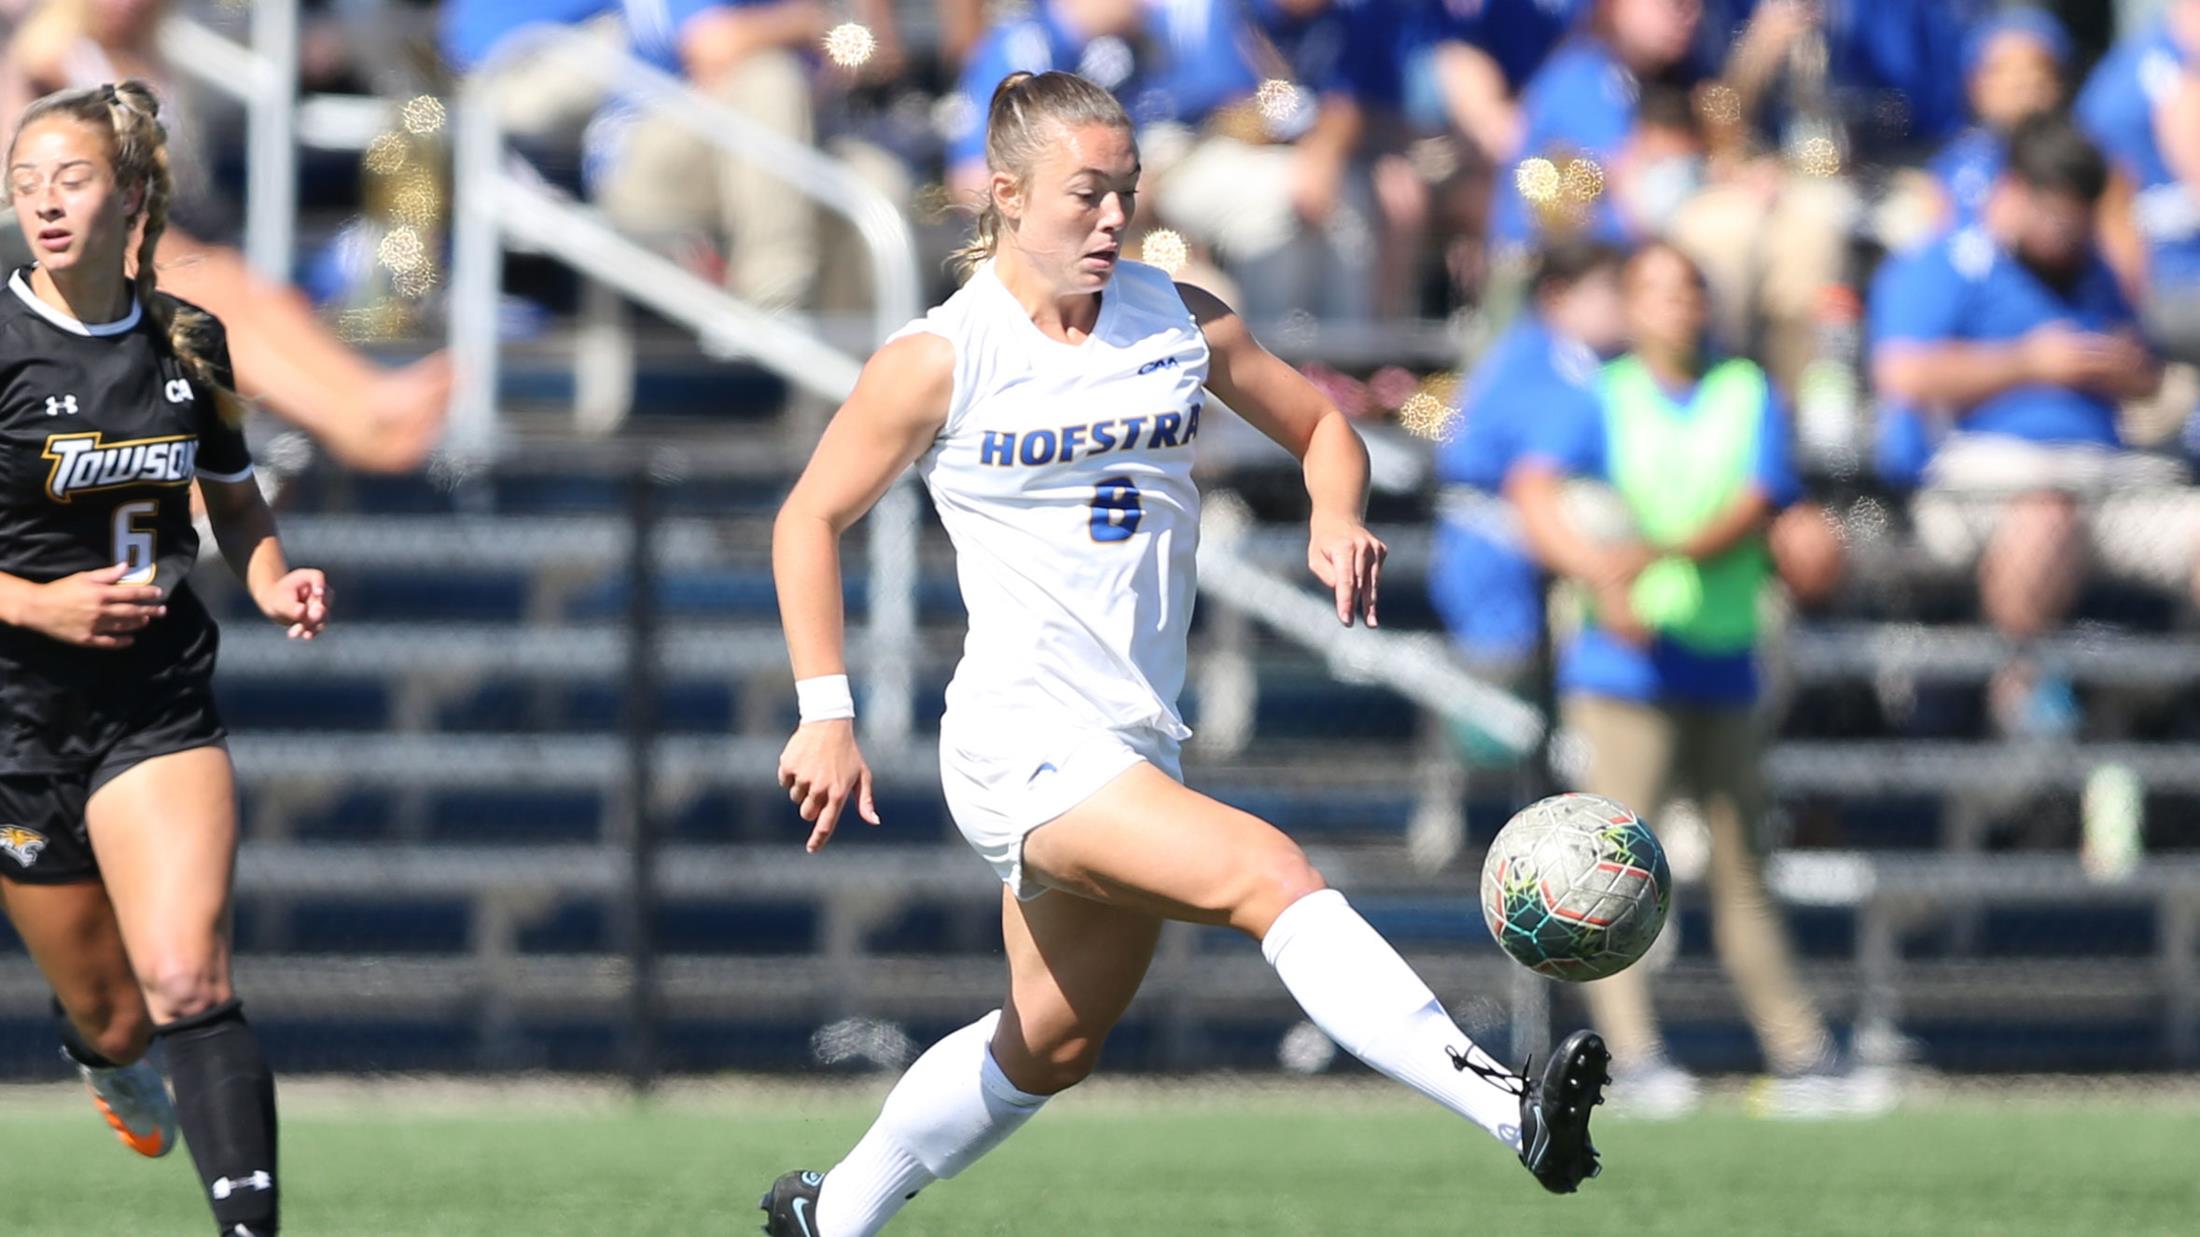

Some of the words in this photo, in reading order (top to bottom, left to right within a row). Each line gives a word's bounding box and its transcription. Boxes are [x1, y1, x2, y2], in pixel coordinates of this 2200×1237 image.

[164, 378, 194, 403] CA
[979, 402, 1201, 466] HOFSTRA
[1089, 476, 1142, 543] 8
[112, 500, 159, 586] 6
